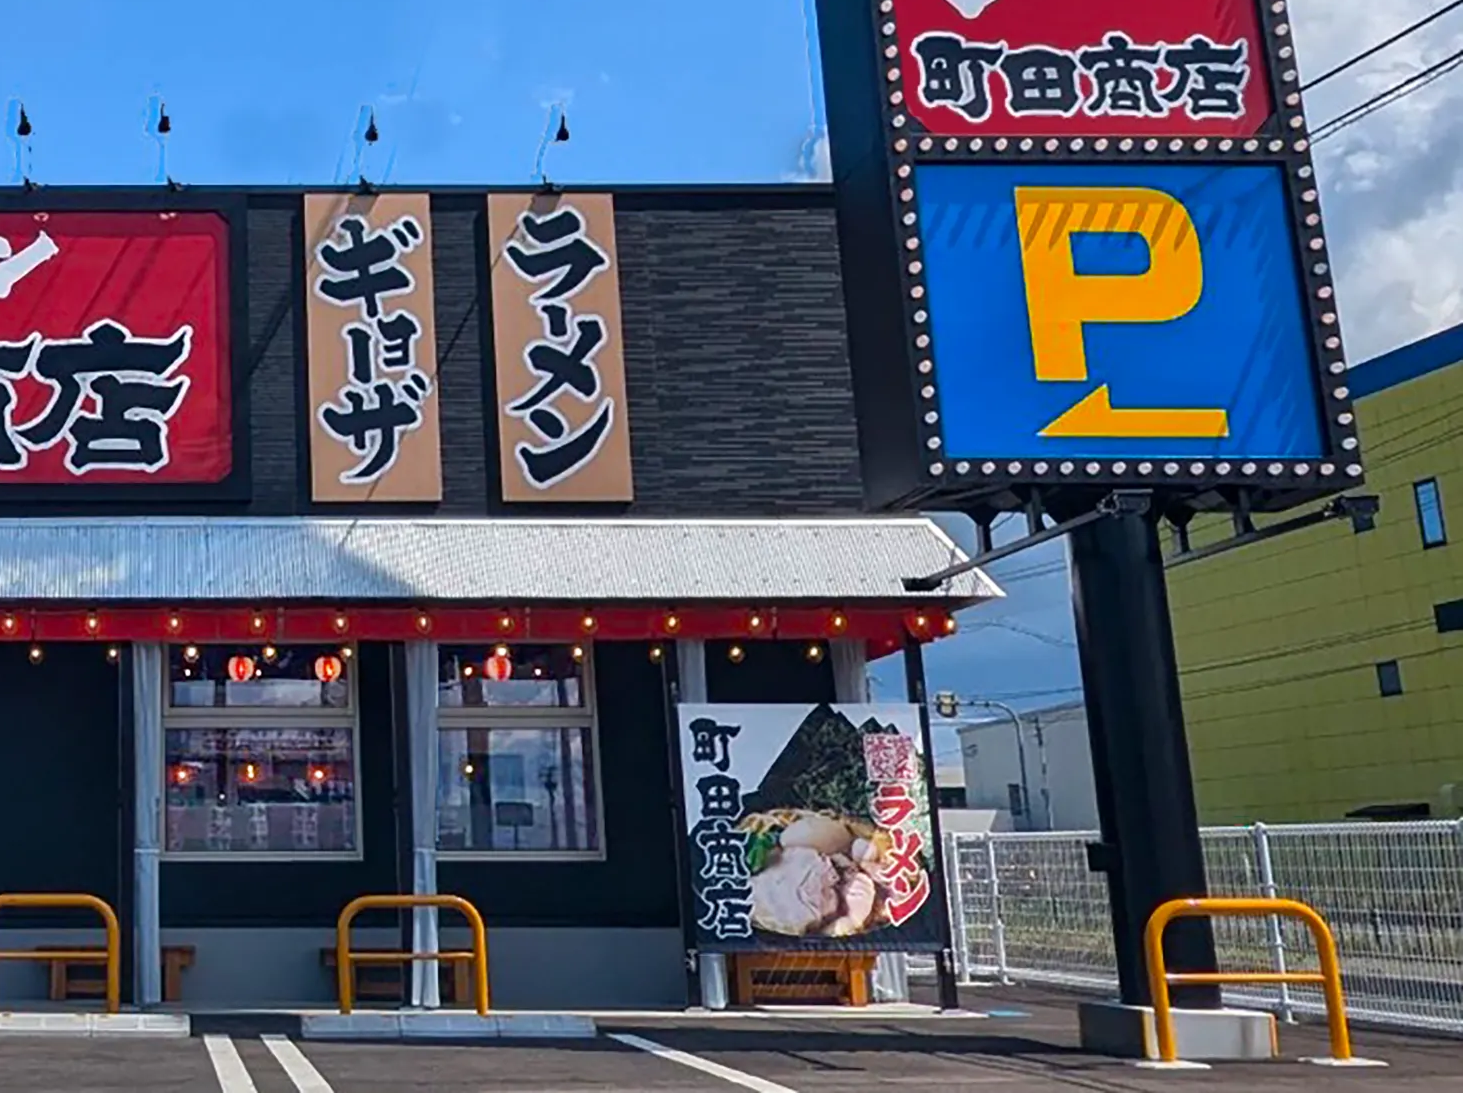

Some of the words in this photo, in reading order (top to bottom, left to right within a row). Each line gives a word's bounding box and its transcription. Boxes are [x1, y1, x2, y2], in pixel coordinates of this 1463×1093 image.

[910, 30, 1251, 123] 町田商店
[315, 214, 433, 484] ギョーザ
[501, 205, 614, 490] ラーメン
[1014, 186, 1204, 382] P
[689, 717, 754, 940] 町田商店
[873, 782, 930, 927] ラーメン
